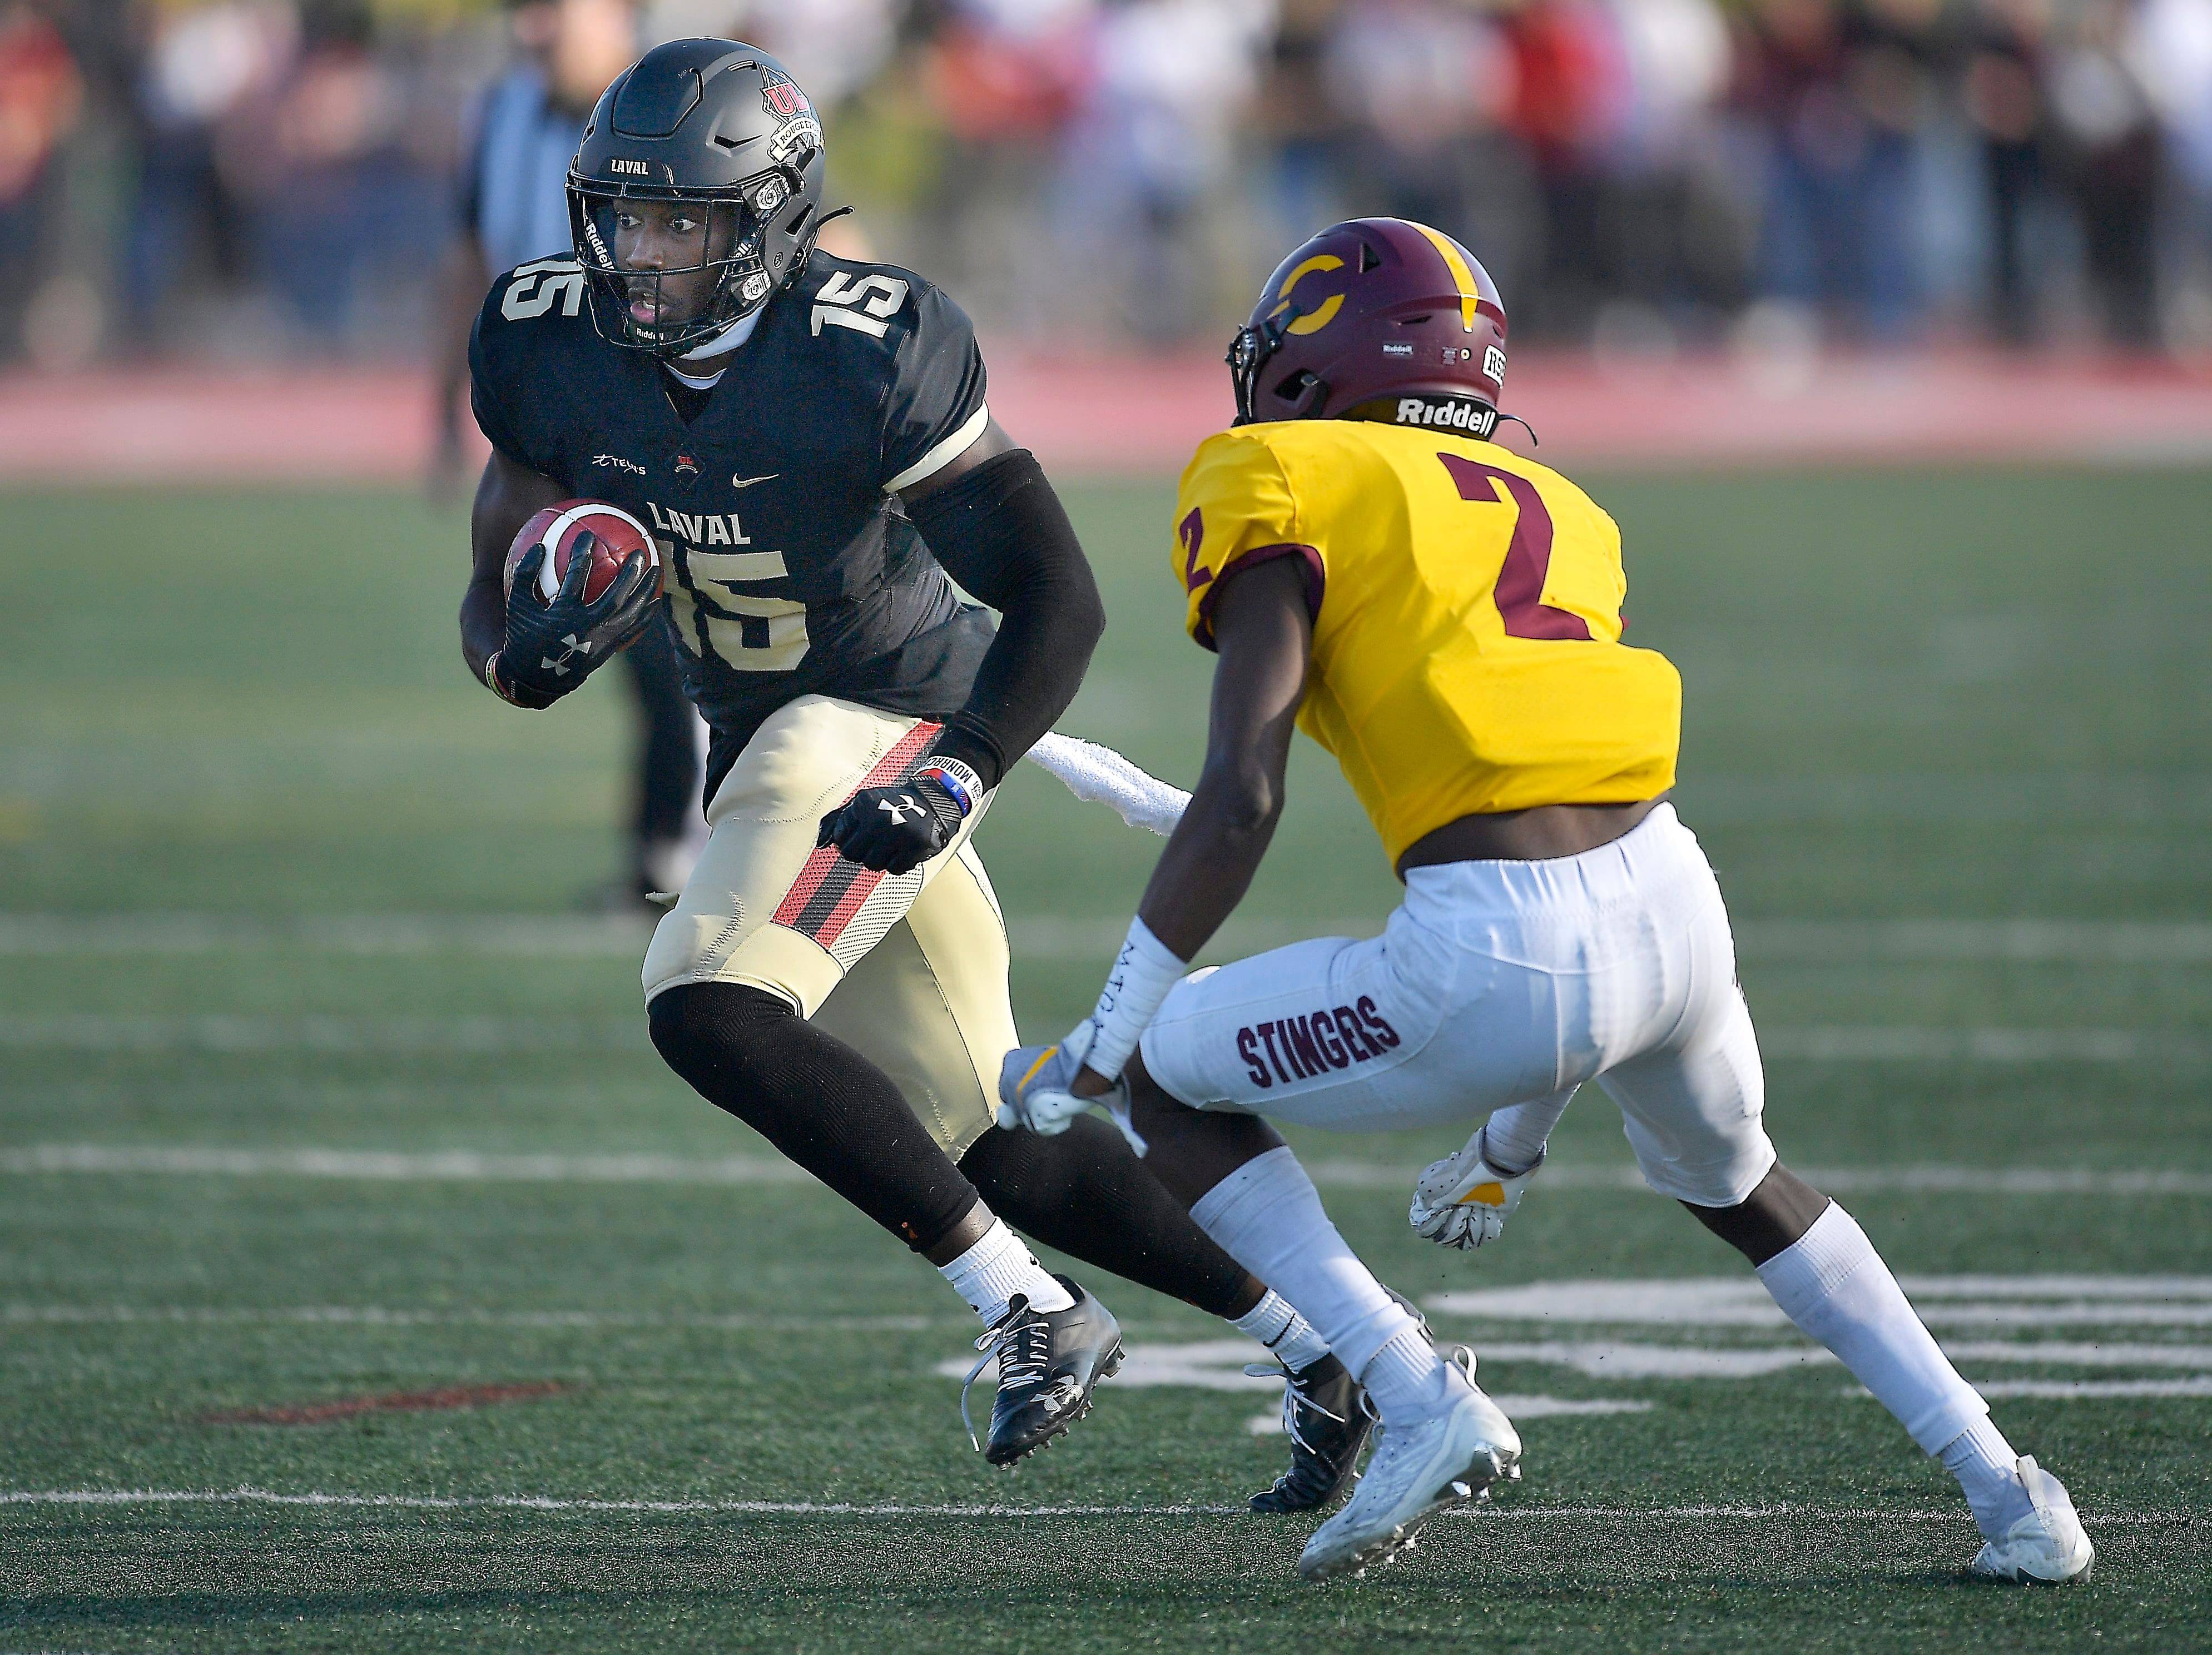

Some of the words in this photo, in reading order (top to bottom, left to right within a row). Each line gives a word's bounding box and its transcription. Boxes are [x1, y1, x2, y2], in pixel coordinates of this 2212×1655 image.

[780, 121, 804, 144] ROUGE
[611, 159, 648, 175] LAVAL
[501, 260, 584, 321] 15
[811, 270, 909, 339] 15
[1396, 398, 1496, 436] Riddell
[647, 502, 750, 545] LAVAL
[1437, 452, 1599, 640] 2
[1179, 507, 1213, 597] 2
[926, 757, 974, 783] MONARC
[1237, 996, 1400, 1089] STINGERS
